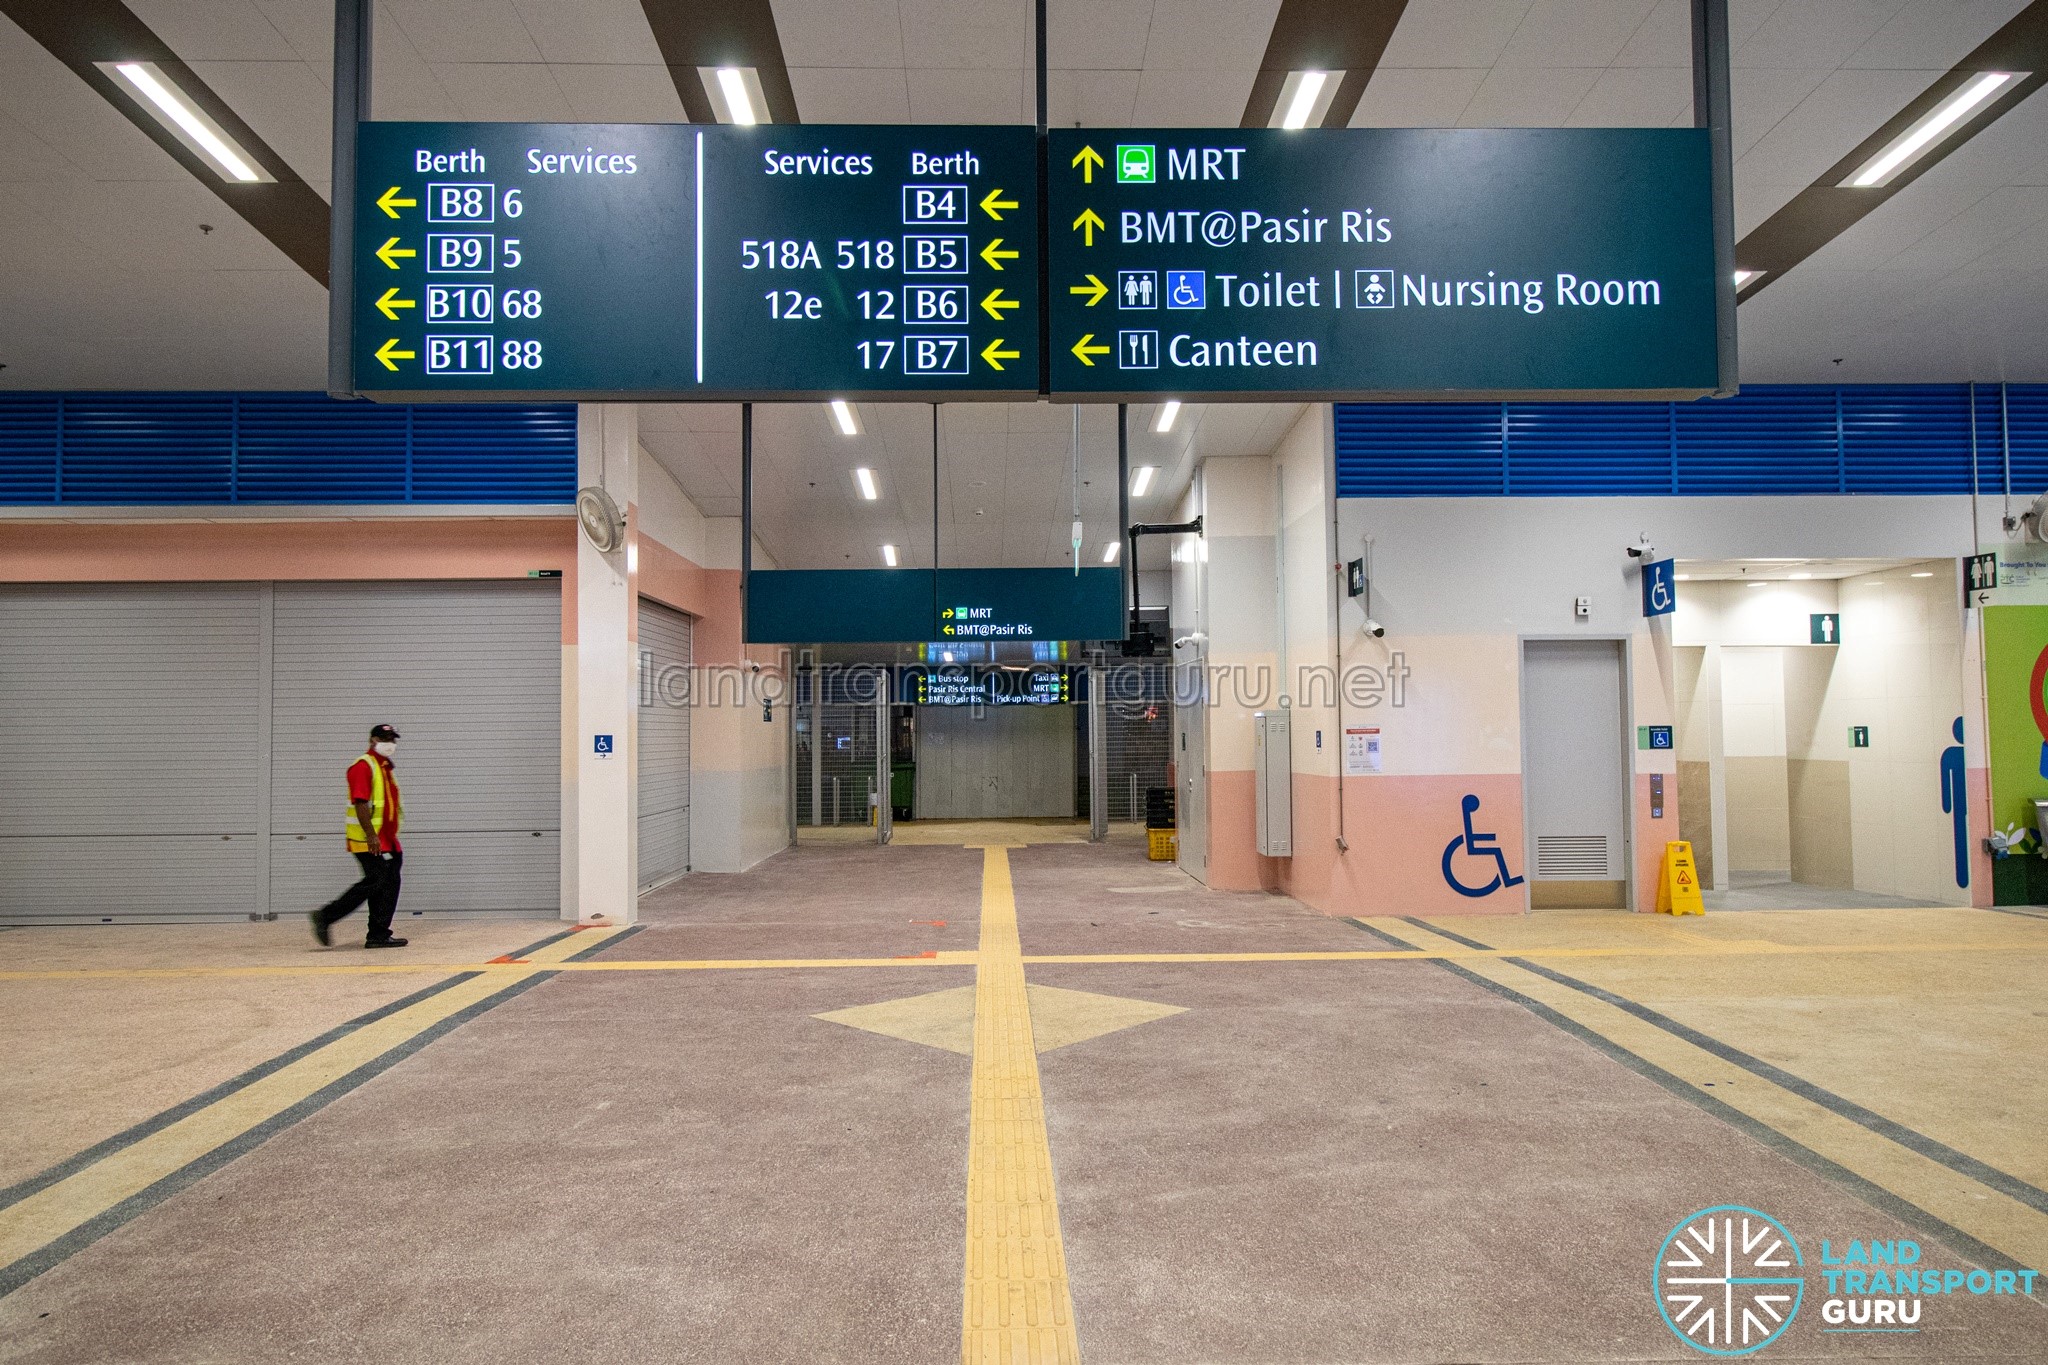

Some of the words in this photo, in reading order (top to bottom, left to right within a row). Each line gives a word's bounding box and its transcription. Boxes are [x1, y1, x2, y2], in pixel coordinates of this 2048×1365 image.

[415, 149, 486, 174] Berth
[526, 149, 638, 175] Services
[764, 151, 873, 176] Services
[911, 151, 980, 175] Berth
[1168, 148, 1246, 181] MRT
[440, 187, 483, 218] B8
[503, 188, 523, 218] 6
[915, 190, 957, 219] B4
[1121, 208, 1328, 247] BMT@Pasir
[1342, 208, 1392, 243] Ris
[440, 238, 483, 268] B9
[503, 239, 522, 268] 5
[741, 240, 822, 269] 518A
[837, 240, 895, 269] 518
[916, 240, 957, 269] B5
[430, 289, 491, 319] B10
[502, 289, 543, 319] 68
[765, 290, 823, 320] 12e
[857, 290, 895, 320] 12
[916, 290, 958, 319] B6
[1214, 271, 1321, 308] Toilet
[1402, 271, 1544, 315] Nursing
[1556, 273, 1660, 306] Room
[430, 339, 489, 369] B11
[502, 340, 543, 370] 88
[856, 341, 895, 370] 17
[916, 340, 958, 370] B7
[1169, 334, 1317, 367] Canteen
[969, 607, 993, 619] MRT
[956, 623, 1015, 637] BMT@Pasir
[1017, 624, 1033, 636] Ris
[928, 684, 946, 693] Pasir
[947, 684, 959, 693] Ris
[959, 684, 986, 693] Central
[938, 675, 952, 683] Bus
[952, 675, 969, 684] stop
[1033, 673, 1049, 682] Taxi
[1033, 684, 1050, 692] MRT
[928, 695, 970, 704] BMT@Pasir
[970, 694, 982, 703] Ris
[996, 694, 1022, 704] Pick-up
[1022, 694, 1040, 703] Point
